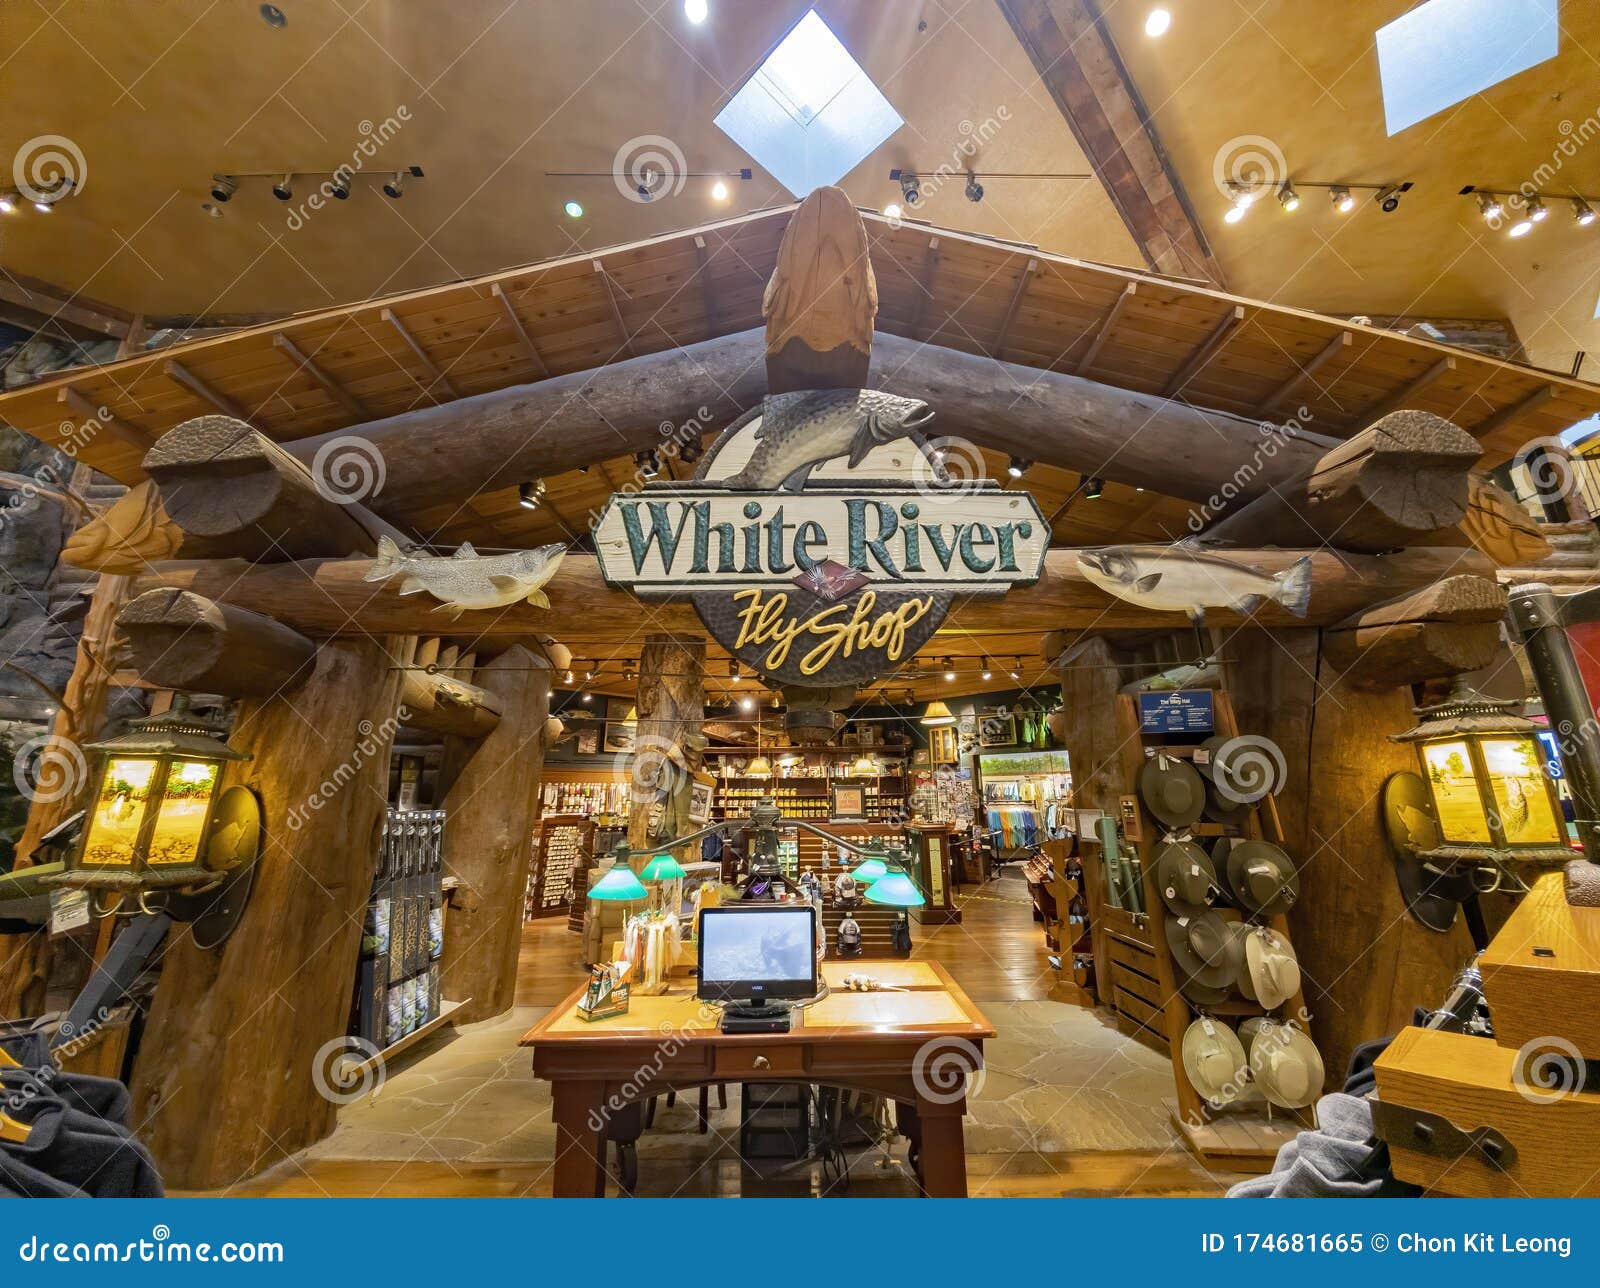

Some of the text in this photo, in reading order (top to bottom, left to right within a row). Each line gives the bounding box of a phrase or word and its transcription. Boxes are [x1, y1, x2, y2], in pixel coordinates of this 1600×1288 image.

[616, 499, 1032, 579] White River
[733, 589, 934, 676] Fly Shop
